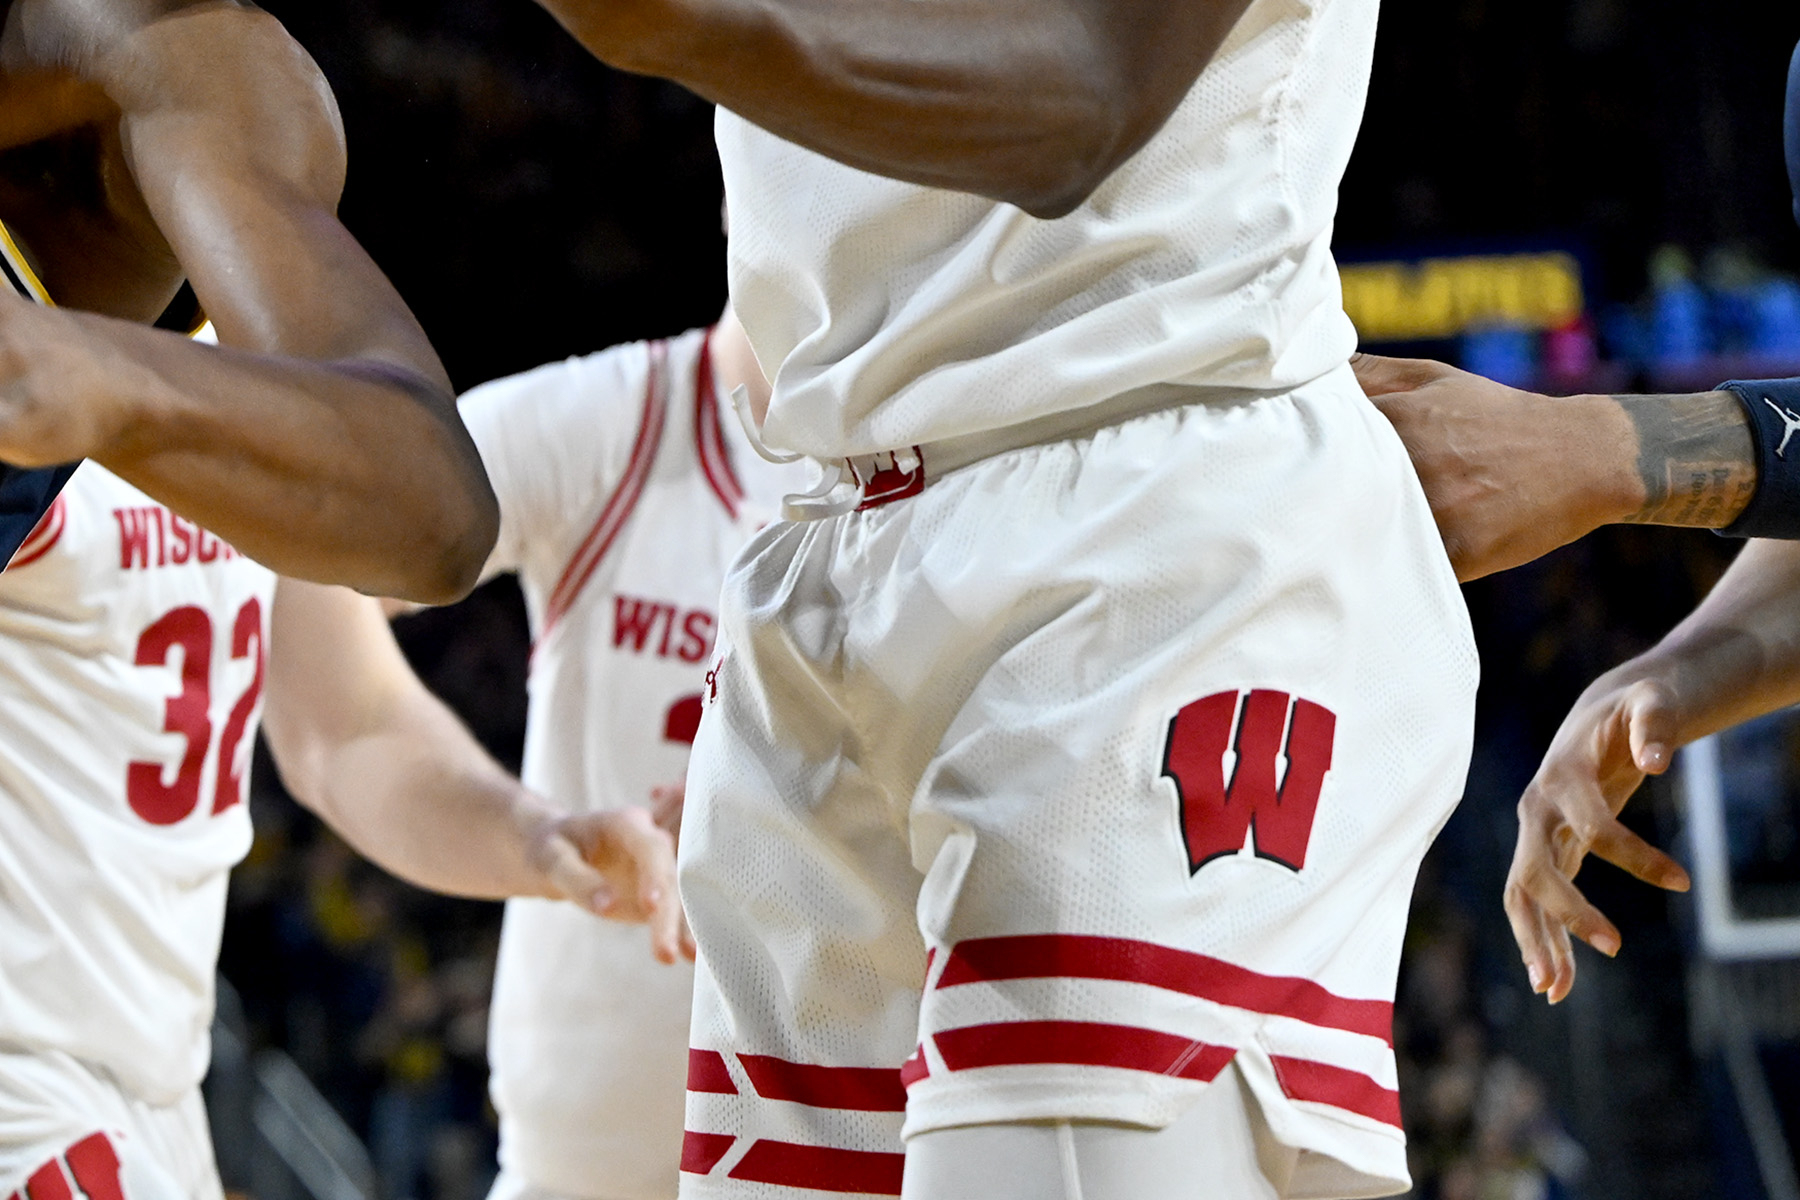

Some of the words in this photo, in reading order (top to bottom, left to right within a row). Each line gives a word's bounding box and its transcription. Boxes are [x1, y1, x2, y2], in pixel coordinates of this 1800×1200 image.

[126, 596, 266, 826] 32
[611, 596, 718, 664] WIS
[1161, 688, 1336, 878] W
